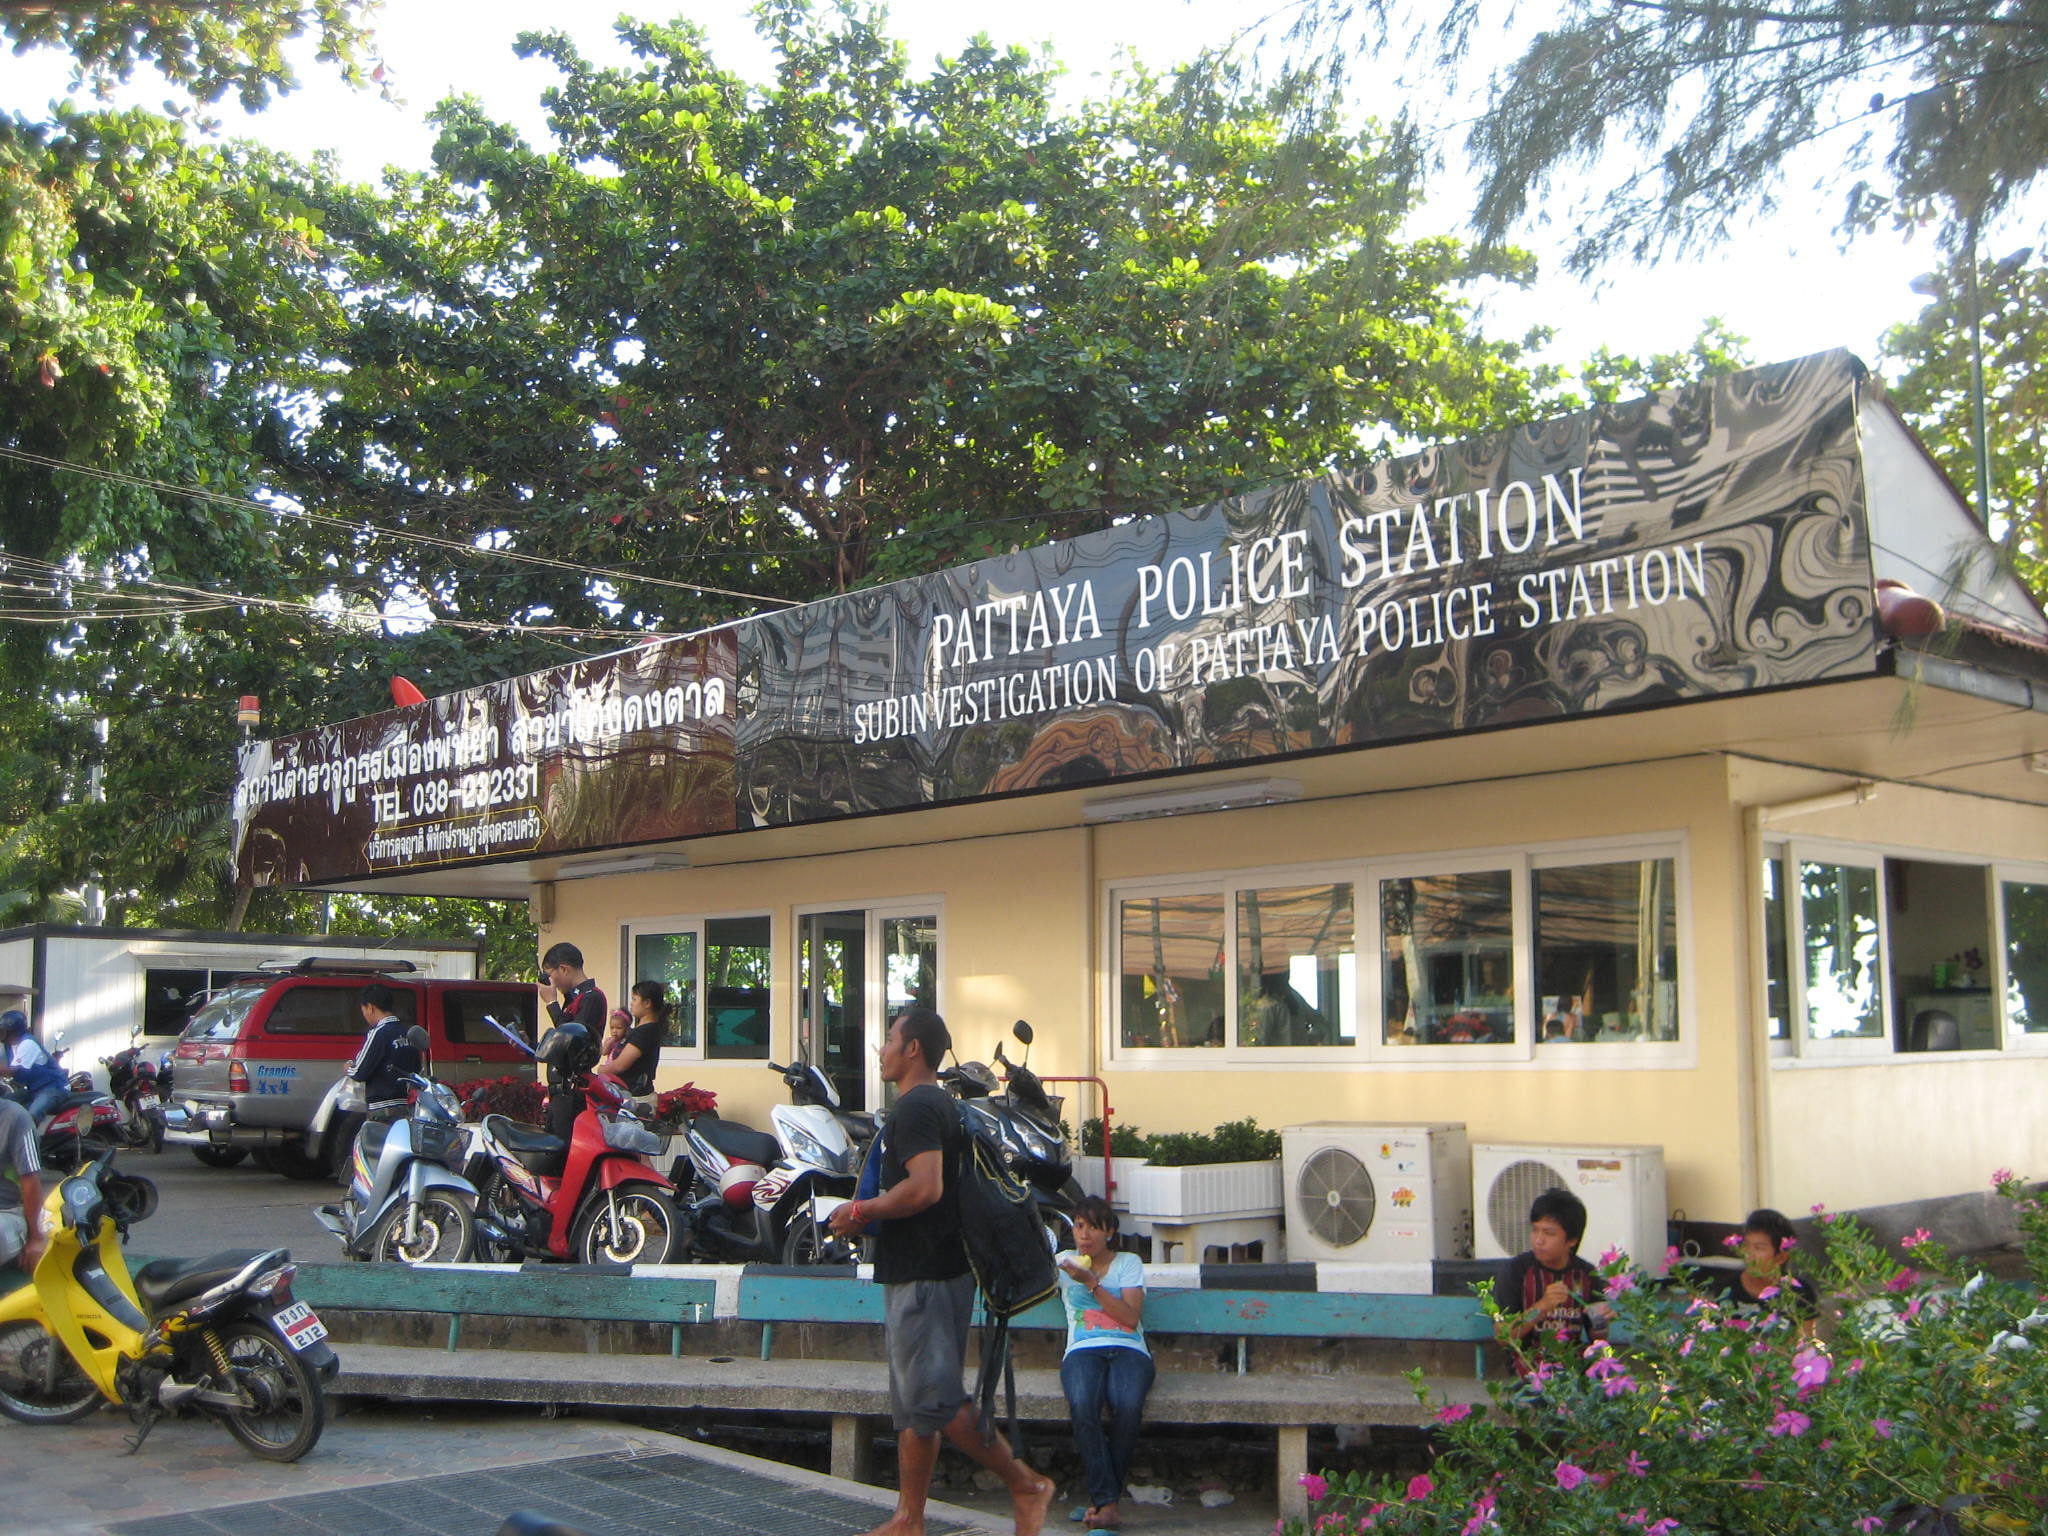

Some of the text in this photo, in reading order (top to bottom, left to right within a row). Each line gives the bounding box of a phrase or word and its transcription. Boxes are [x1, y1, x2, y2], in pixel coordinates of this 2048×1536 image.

[934, 467, 1584, 671] PATTAYA POLICE STATION
[854, 542, 1705, 744] SUBINVESTIGATION OF PATTAYA POLICE STATION
[372, 763, 538, 822] TEL. 038-232331
[257, 1065, 297, 1078] Grandis
[295, 1325, 323, 1346] 212
